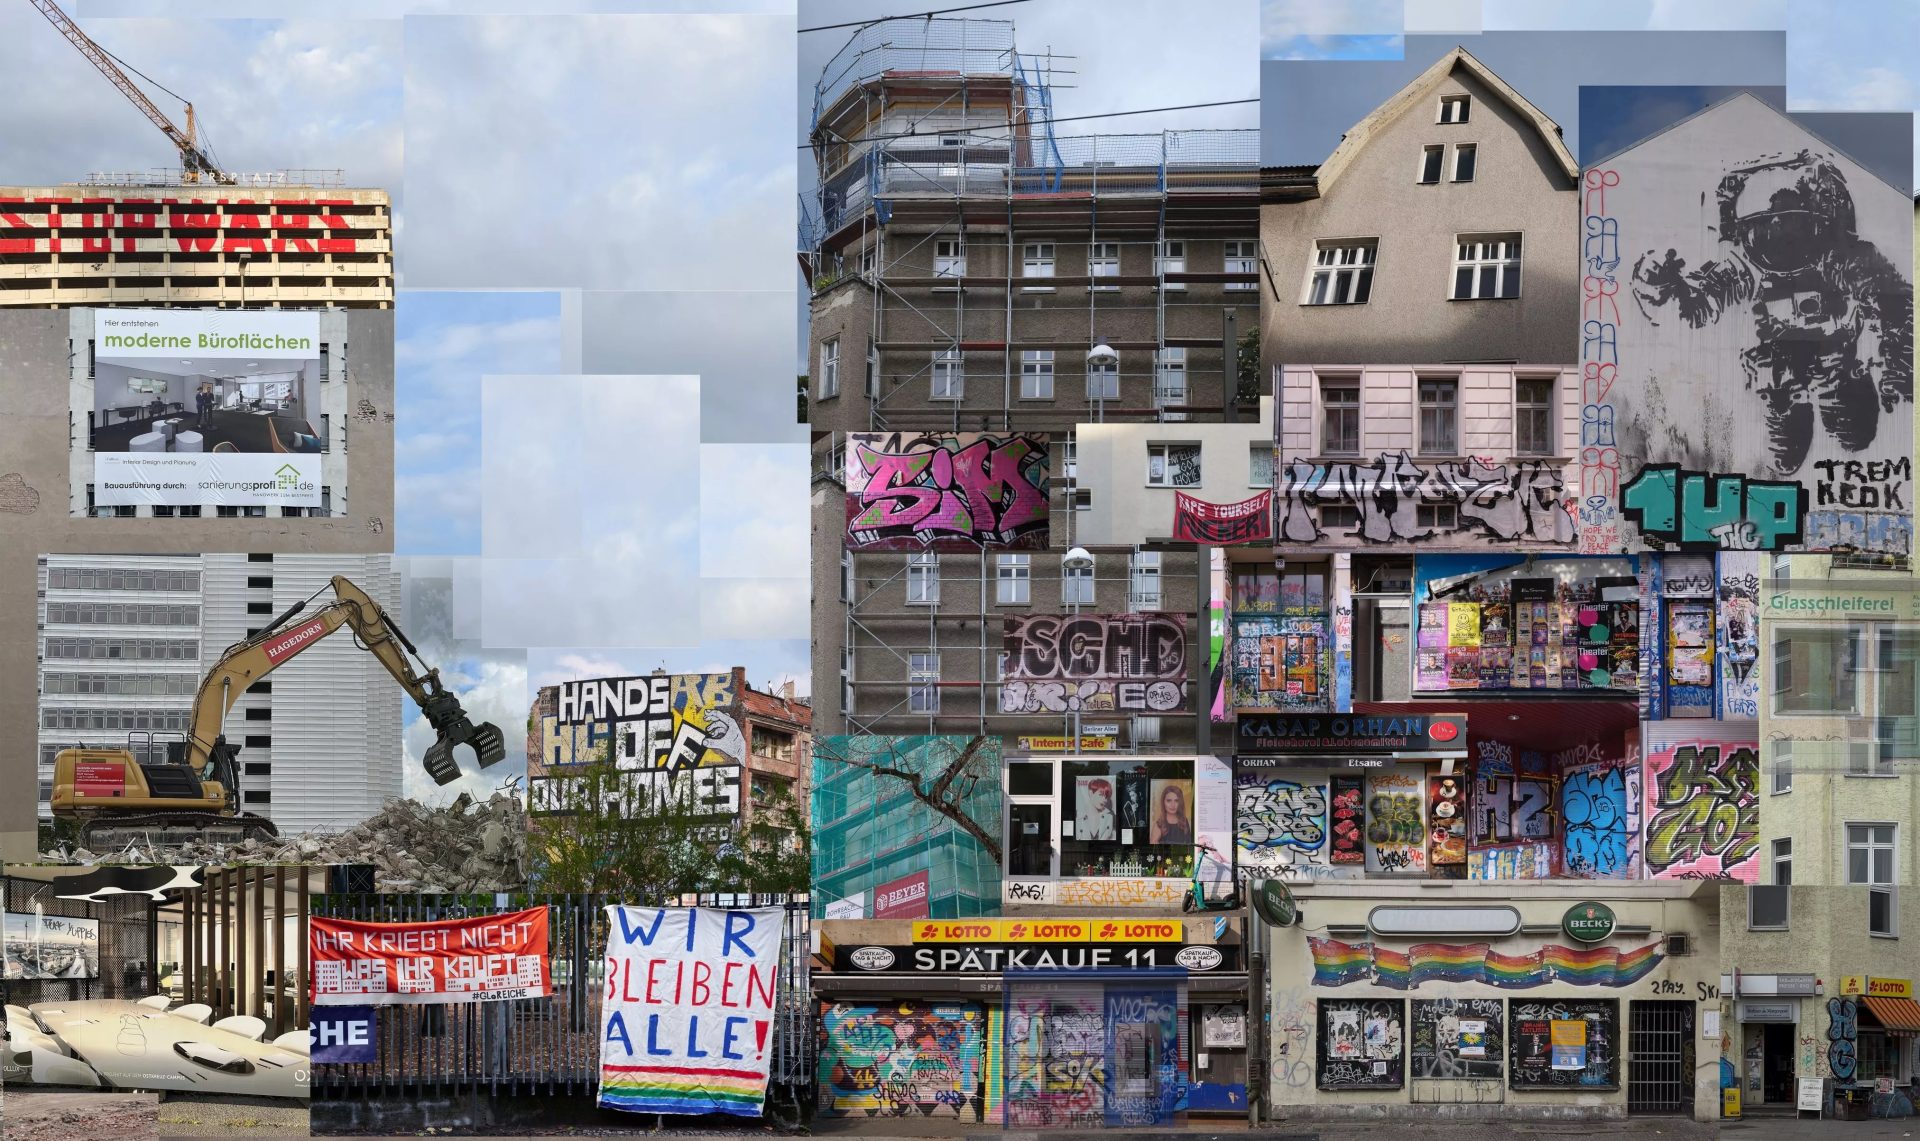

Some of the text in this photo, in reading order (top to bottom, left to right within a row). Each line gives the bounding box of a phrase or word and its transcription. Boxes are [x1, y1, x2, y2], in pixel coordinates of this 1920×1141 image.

[162, 198, 356, 253] WARS
[104, 319, 119, 327] Hier
[105, 333, 310, 350] moderne Büroflächen
[142, 459, 160, 467] Design
[174, 459, 197, 467] Planung
[1814, 457, 1911, 483] TREM
[104, 482, 187, 491] Bauausführung durch:
[1178, 492, 1269, 518] RAPE YOURSELF
[1584, 526, 1602, 534] HOPE
[1579, 604, 1609, 612] Theater
[1770, 595, 1894, 611] Glasschleiferei
[268, 623, 322, 659] HAGEDORN
[1578, 647, 1609, 656] Theater
[558, 678, 672, 722] HANDS
[1241, 718, 1321, 737] KASAP
[1331, 717, 1423, 736] ORHAN
[615, 718, 706, 772] OFF
[1080, 737, 1104, 748] Café
[1349, 759, 1382, 767] Etsane
[888, 882, 926, 902] BEYER
[1009, 883, 1045, 900] RWS!
[1269, 891, 1293, 915] BECK
[617, 906, 756, 957] WIR
[1033, 924, 1082, 938] LOTTO
[1124, 924, 1174, 938] LOTTO
[1570, 918, 1611, 928] BECK'S
[315, 922, 533, 952] IHR KRIEGT NICHT
[945, 926, 992, 938] LOTTO
[341, 953, 516, 980] WAS IHR KAUFT
[915, 946, 1156, 971] SPÄTKAUF 11
[608, 957, 776, 1009] BLEIBEN
[1878, 982, 1905, 994] LOTTO
[607, 1011, 770, 1061] ALLE!
